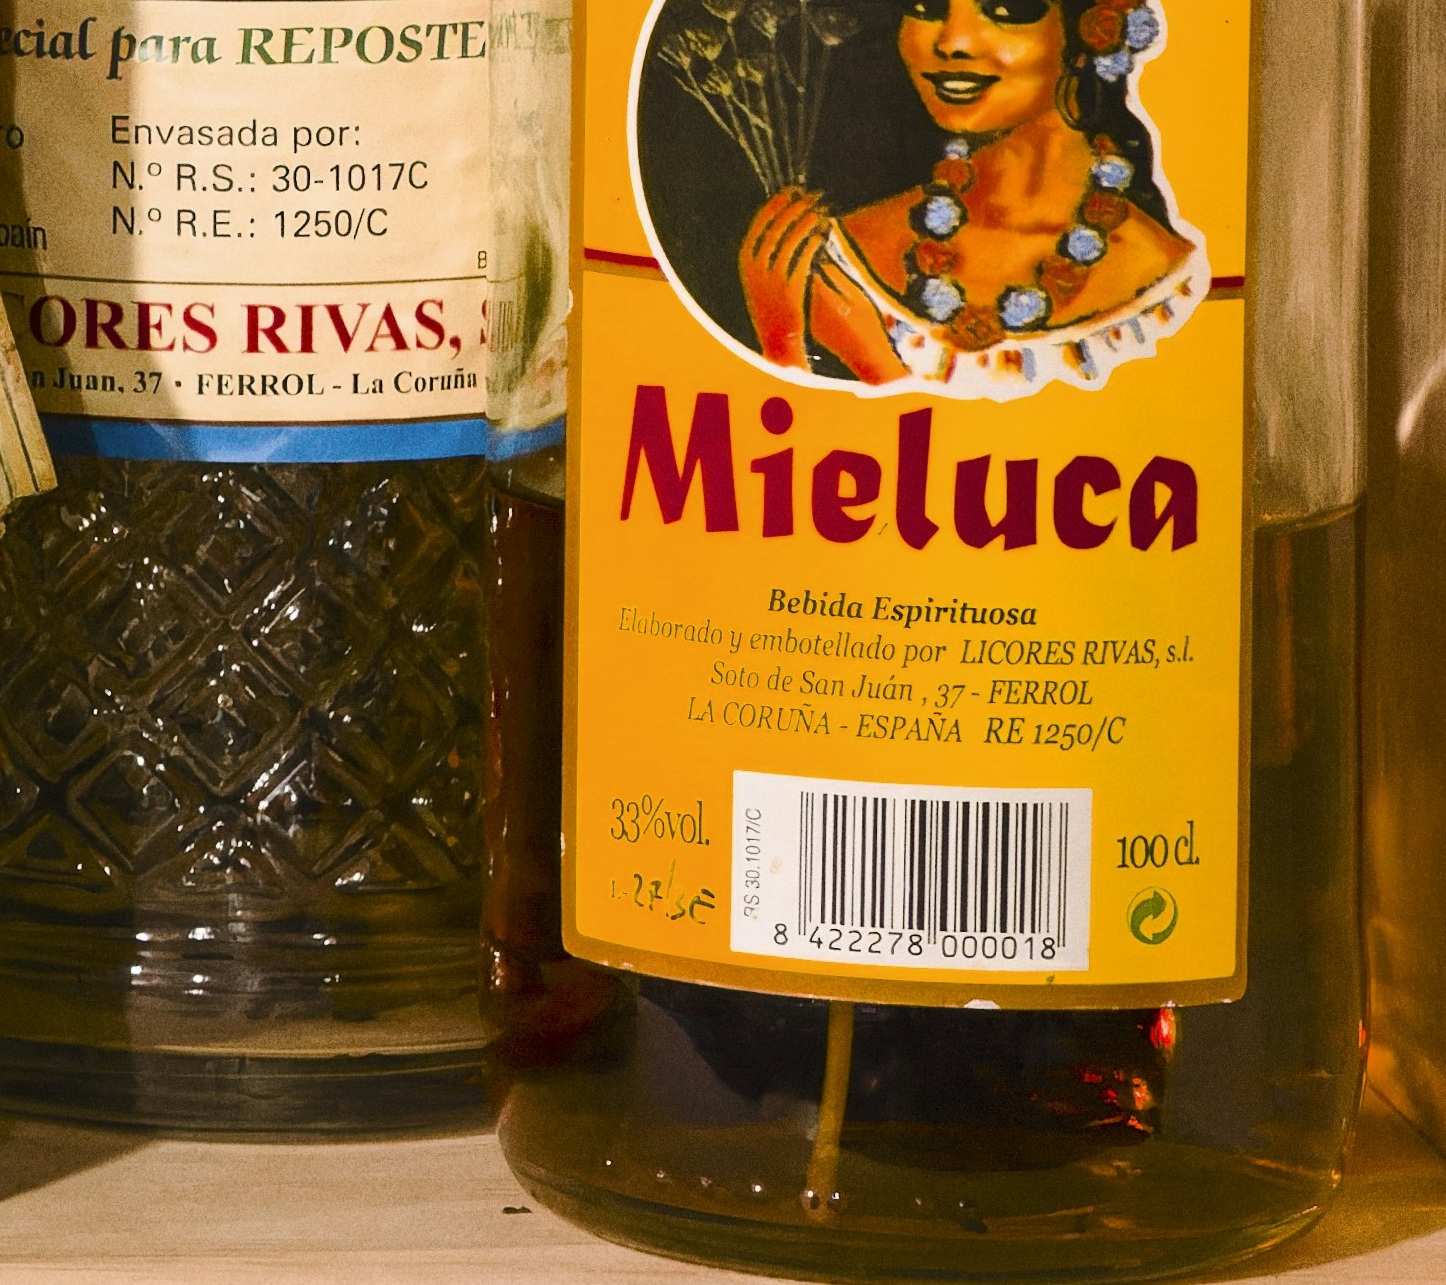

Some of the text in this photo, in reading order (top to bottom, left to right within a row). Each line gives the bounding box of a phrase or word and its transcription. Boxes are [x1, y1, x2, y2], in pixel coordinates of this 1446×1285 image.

[105, 24, 223, 81] para
[234, 20, 488, 66] REPOSTE
[110, 114, 280, 148] Envasada
[290, 122, 362, 154] por:
[175, 162, 257, 194] R.S.:
[270, 160, 430, 194] 30-1017C
[175, 208, 257, 238] R.E.:
[274, 207, 390, 241] 1250/C
[240, 297, 462, 361] RIVAS,
[52, 366, 126, 395] Juan,
[132, 370, 163, 395] 37
[196, 371, 326, 397] FERROL
[350, 372, 384, 396] La
[393, 366, 478, 395] Coruña
[619, 384, 1199, 553] Mieluca
[767, 587, 1038, 629] Bebida Espirituosa
[617, 606, 1195, 670] Elaborado y embotellado por LICORES RIVAS, s.l.
[710, 659, 761, 690] Soto
[765, 664, 794, 694] de
[798, 669, 845, 698] San
[934, 683, 967, 710] 37
[986, 679, 1094, 706] FERROL
[686, 695, 716, 724] LA
[722, 700, 831, 736] CORUÑA
[855, 711, 963, 744] ESPAÑA
[983, 716, 1028, 745] RE
[1030, 715, 1128, 753] 1250/C
[744, 807, 763, 890] 30.1017/C
[1114, 833, 1169, 872] 100
[772, 922, 1058, 962] 8 422278 000018
